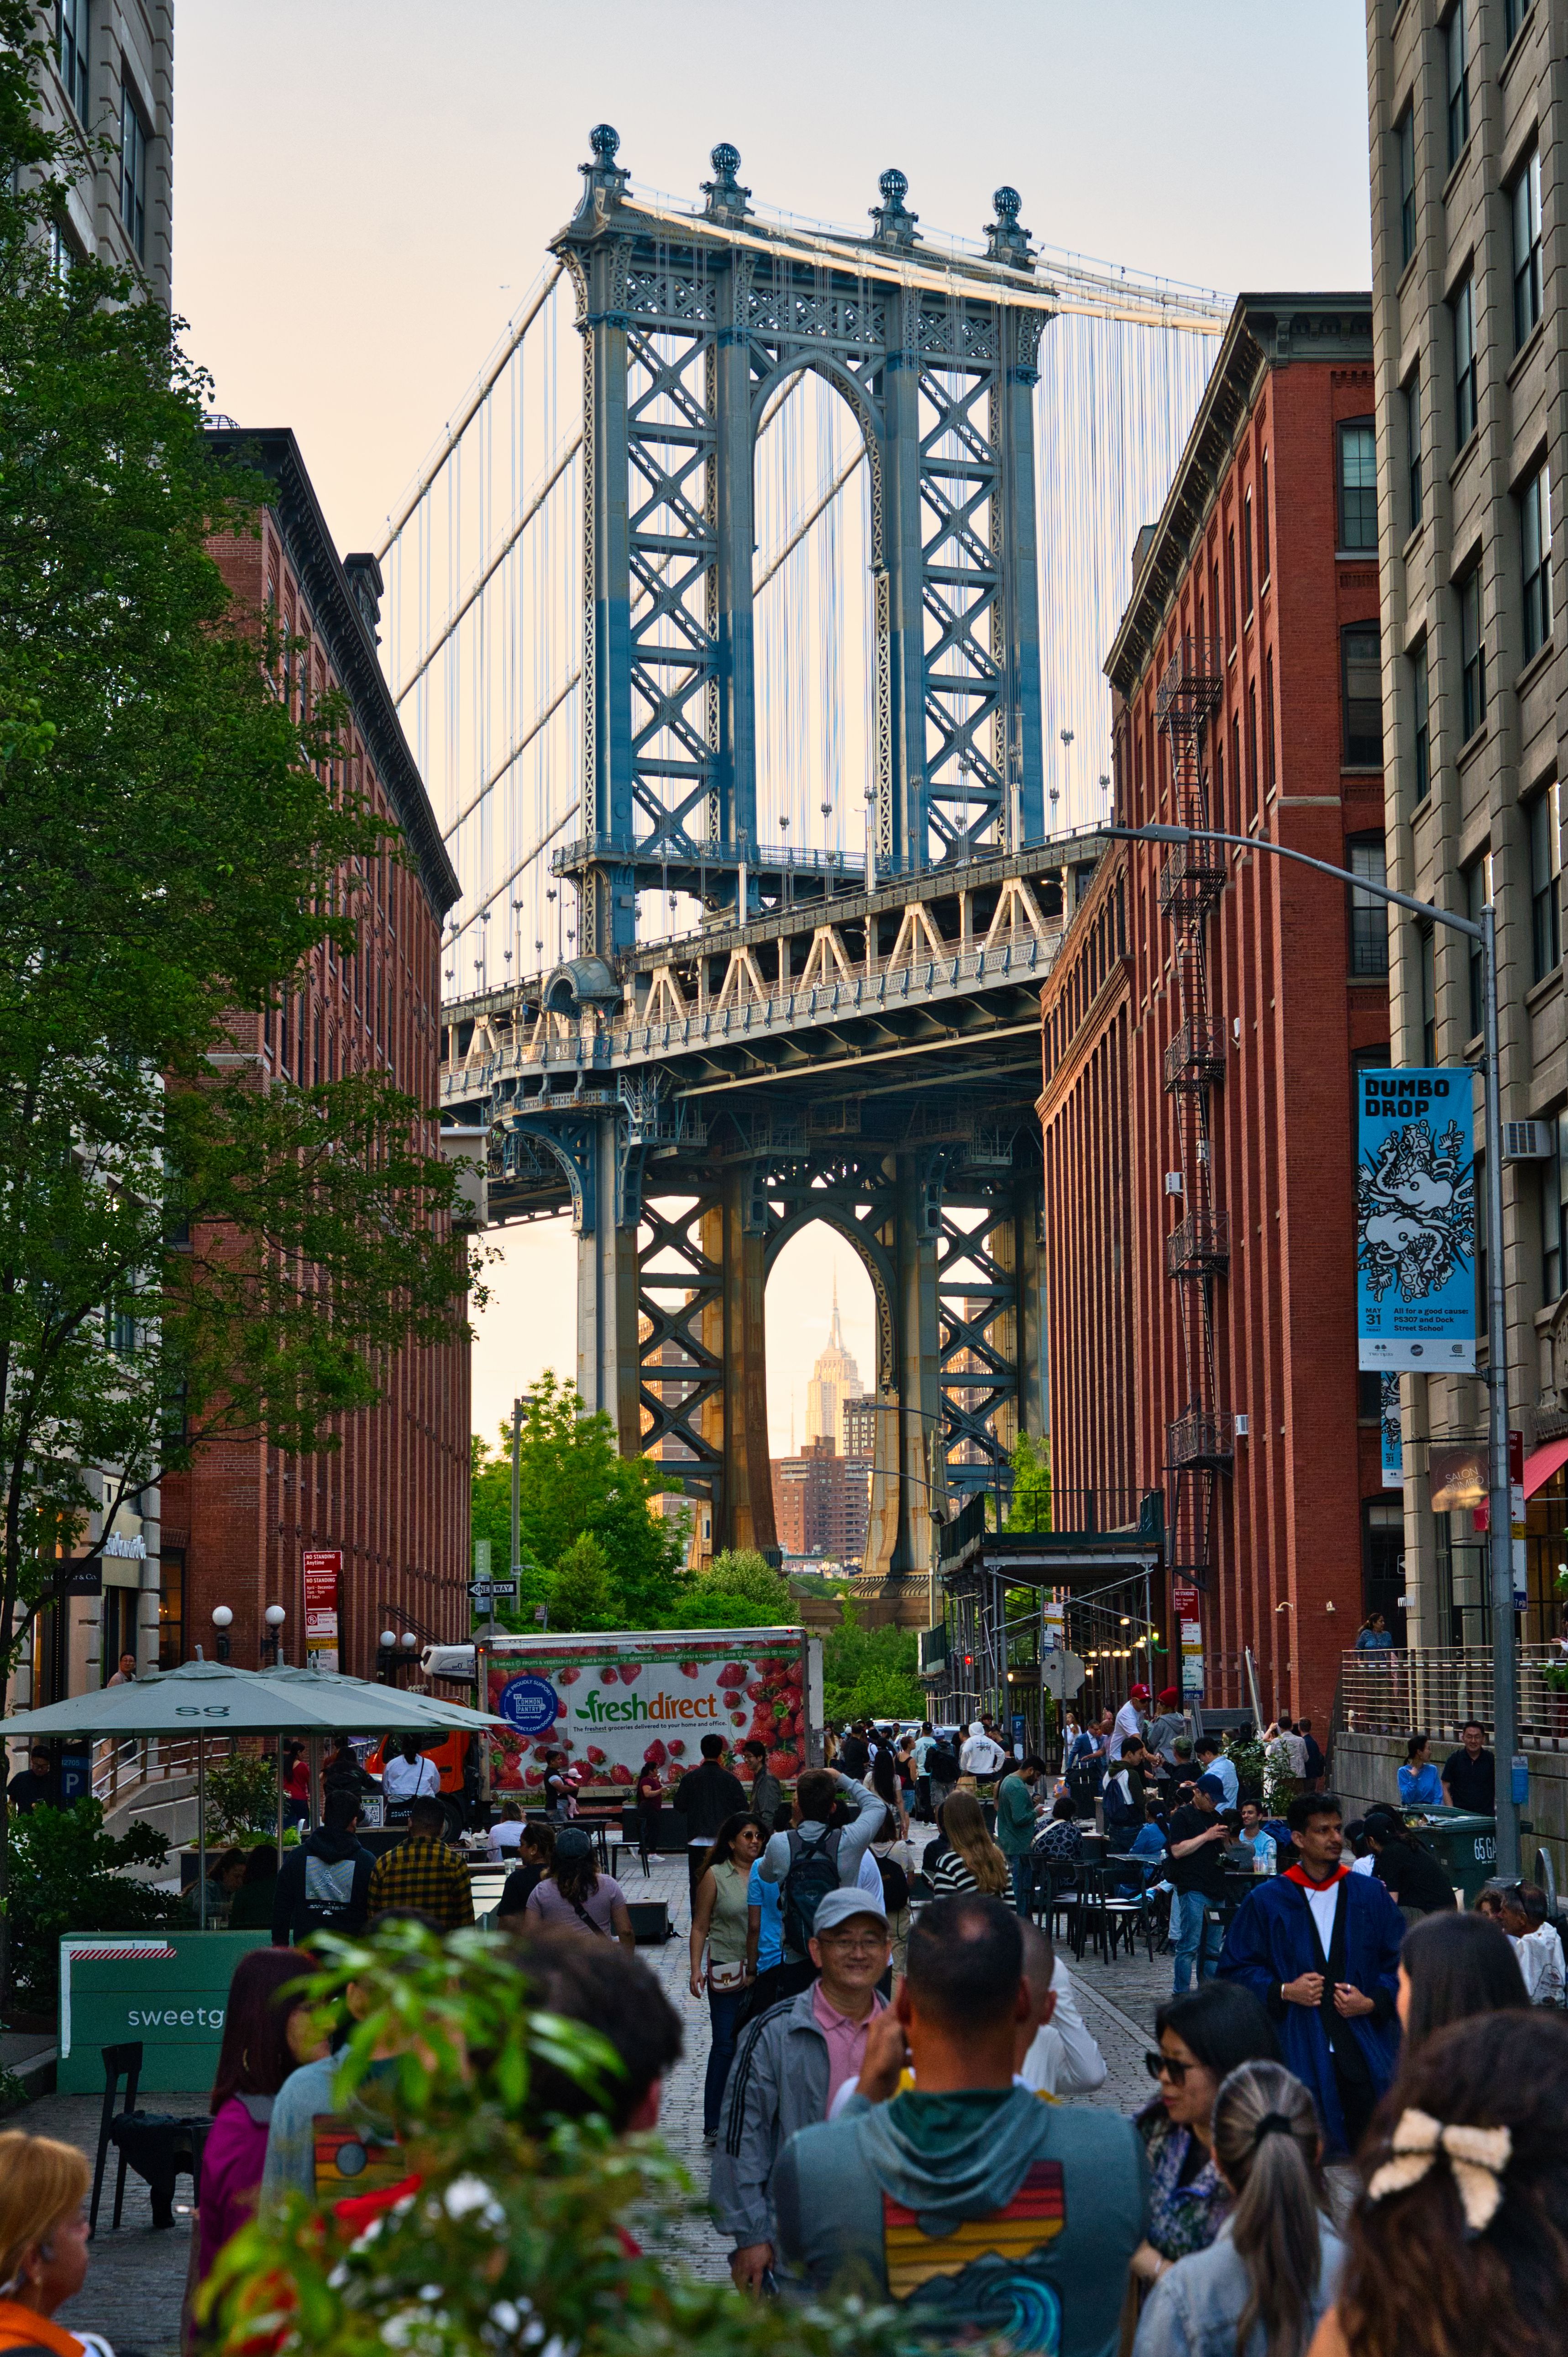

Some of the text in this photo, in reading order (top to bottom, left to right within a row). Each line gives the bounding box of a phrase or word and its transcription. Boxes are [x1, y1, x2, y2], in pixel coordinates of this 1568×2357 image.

[1365, 1079, 1449, 1097] DUMBO
[1365, 1099, 1429, 1117] DROP
[1366, 1314, 1381, 1325] 31
[1445, 1466, 1479, 1483] SALON
[1445, 1476, 1484, 1494] DUMBO
[505, 1680, 552, 1697] WE PROUDLY SUPPORT
[175, 1706, 231, 1717] sg
[585, 1690, 718, 1723] freshdirect
[66, 1773, 79, 1794] P
[1474, 1837, 1497, 1860] 65 GA
[128, 2007, 225, 2029] sweetg
